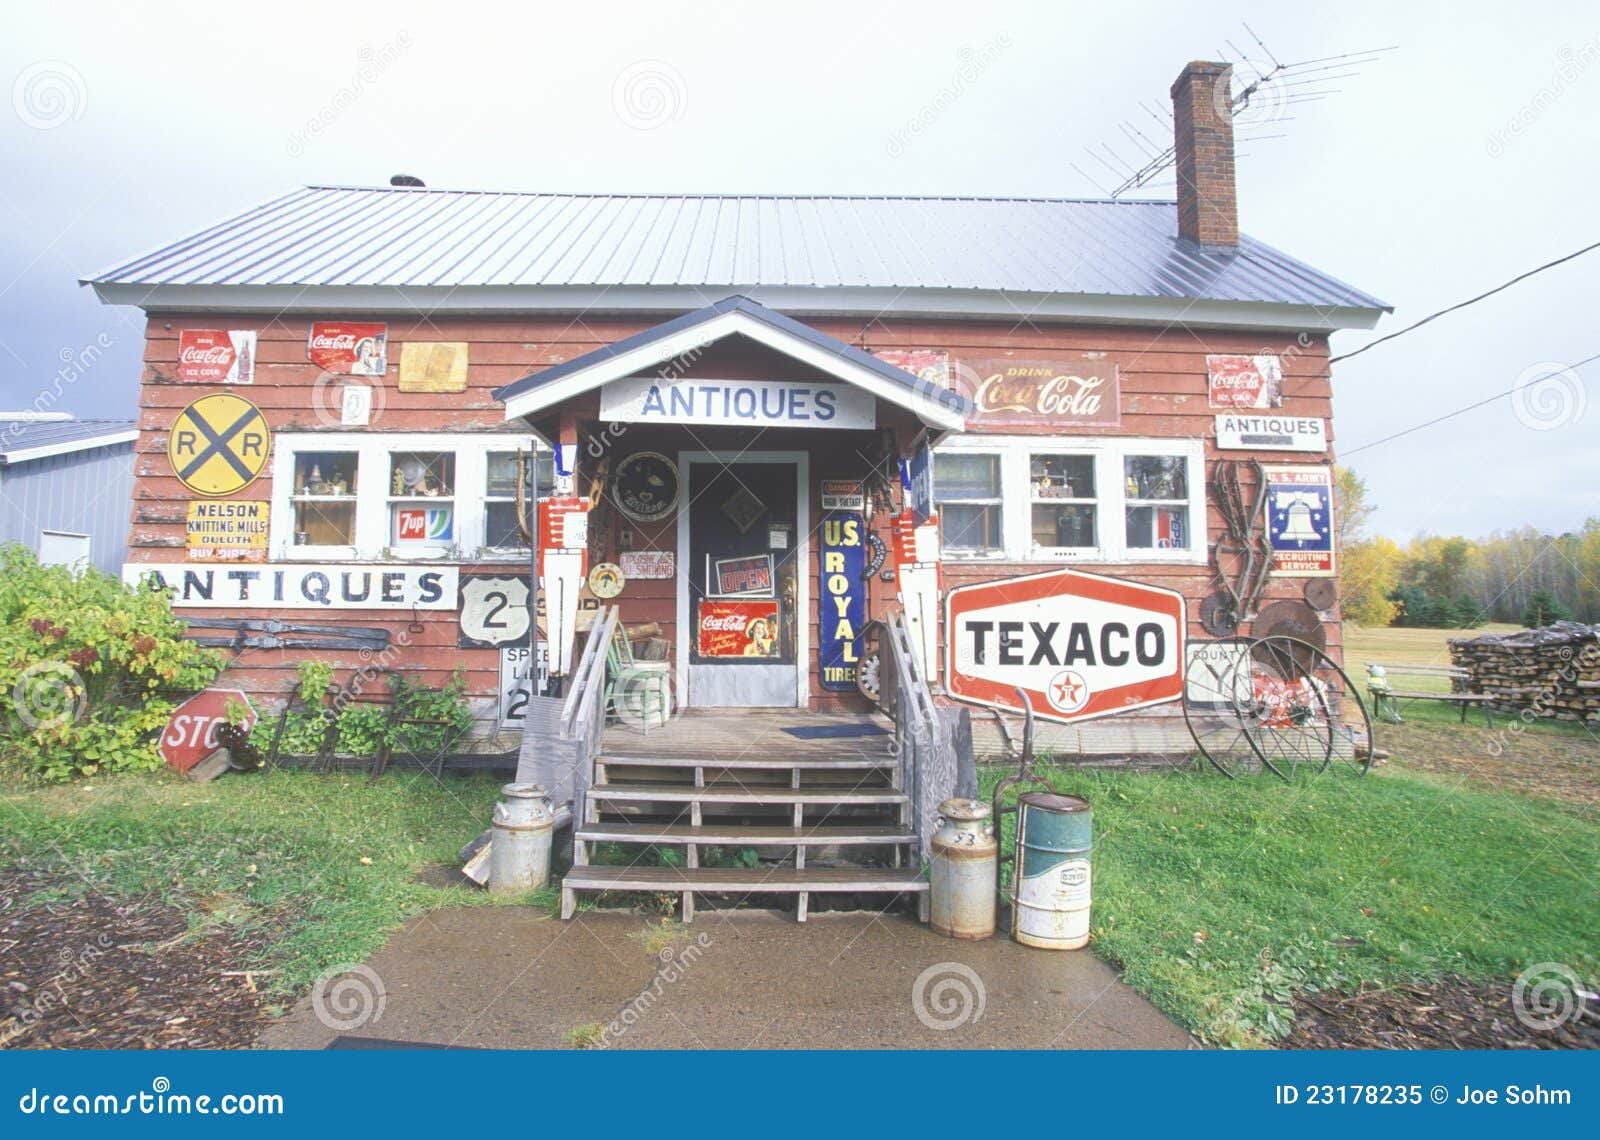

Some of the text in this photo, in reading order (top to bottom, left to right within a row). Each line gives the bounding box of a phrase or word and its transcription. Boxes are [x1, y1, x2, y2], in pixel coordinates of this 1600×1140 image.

[1008, 368, 1054, 377] DRINK
[641, 385, 836, 421] ANTIQUES
[1225, 419, 1320, 435] ANTIQUES
[177, 431, 263, 456] R R
[1295, 473, 1326, 483] ARMY
[198, 504, 258, 517] NELSON
[188, 521, 265, 533] KNITTING MILLS
[825, 520, 860, 546] U.S.
[1171, 512, 1182, 548] PEPS
[201, 536, 251, 544] DULUTH
[189, 548, 262, 559] BUY DIRECT
[1281, 561, 1320, 570] SERVICE
[721, 567, 770, 592] OPEN
[483, 591, 507, 628] 2
[825, 552, 858, 662] ROYAL
[966, 621, 1165, 666] TEXACO
[1194, 650, 1246, 661] COUNT
[513, 667, 546, 680] LIMI
[167, 714, 249, 749] STO
